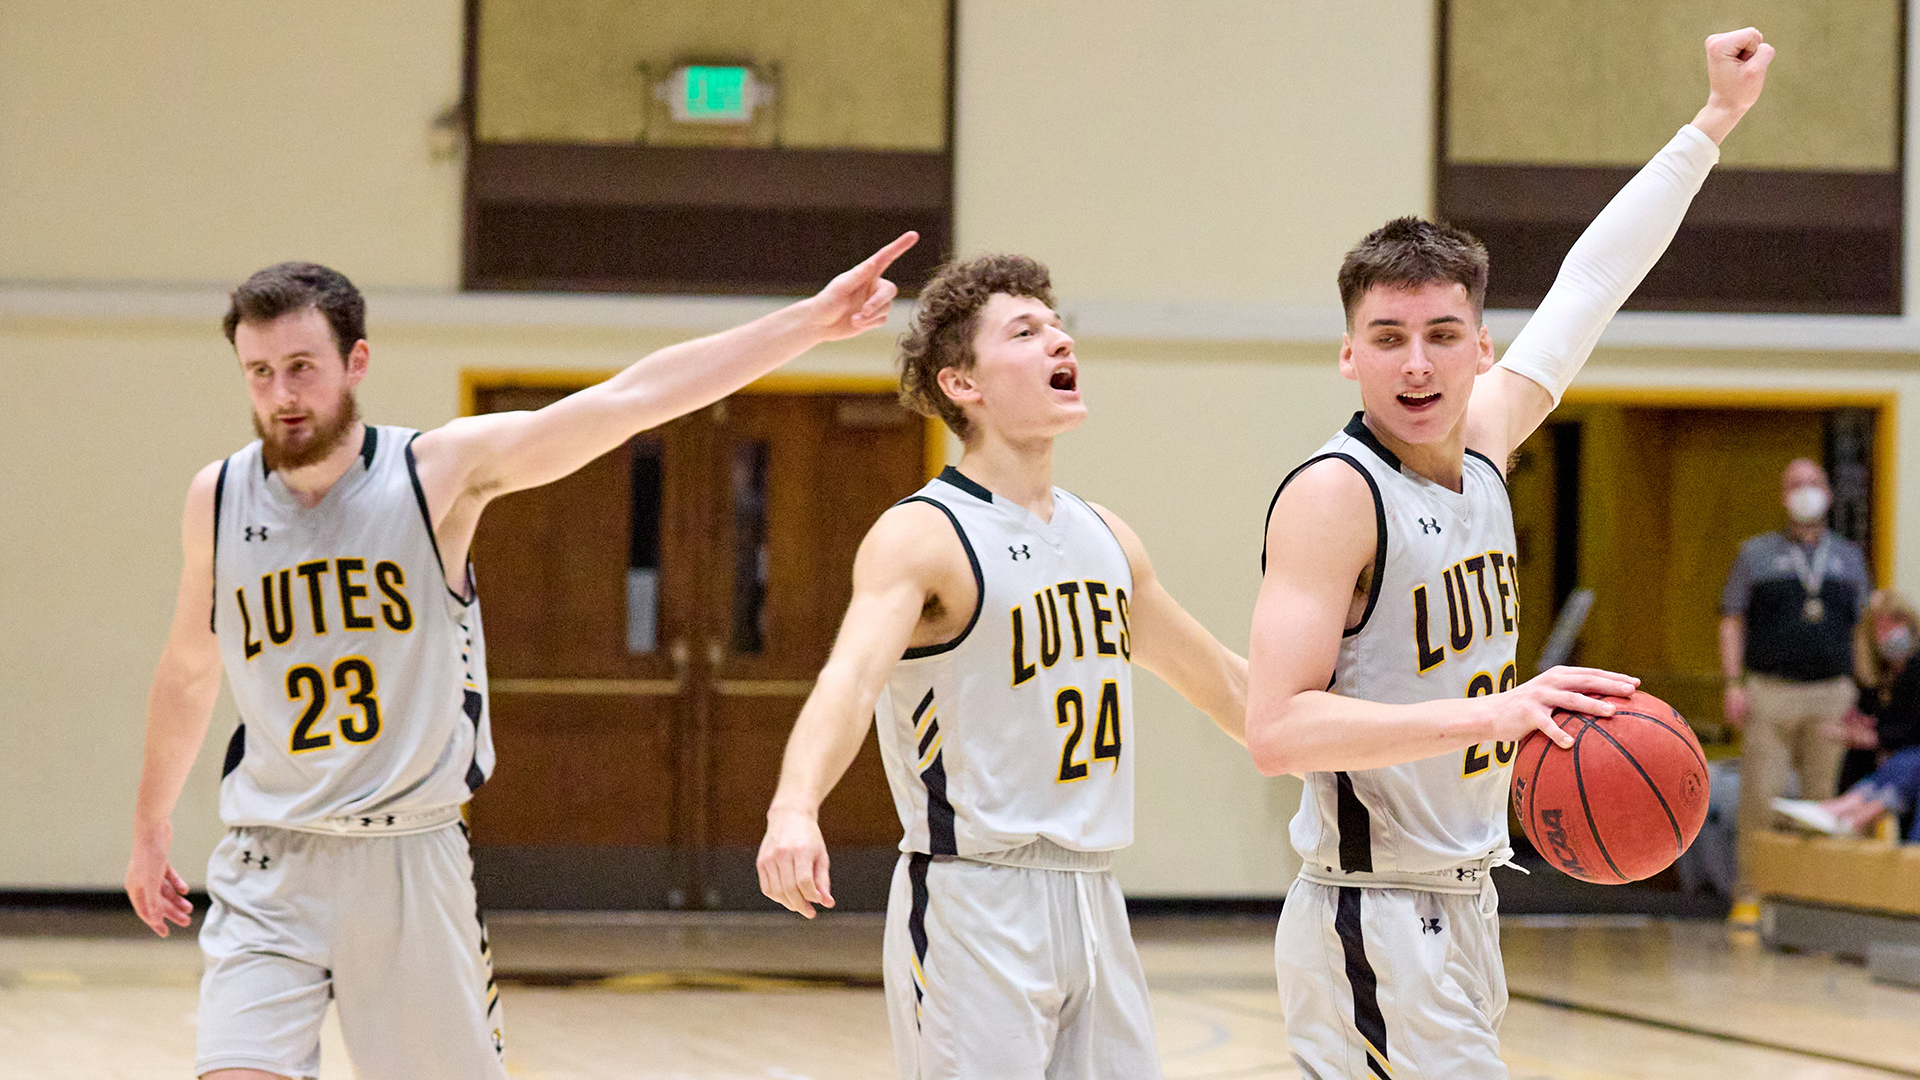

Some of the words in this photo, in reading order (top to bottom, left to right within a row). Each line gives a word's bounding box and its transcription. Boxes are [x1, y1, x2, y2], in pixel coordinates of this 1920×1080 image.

[236, 557, 414, 661] LUTES
[1010, 578, 1131, 688] LUTES
[285, 654, 383, 755] 23
[1054, 678, 1122, 784] 24
